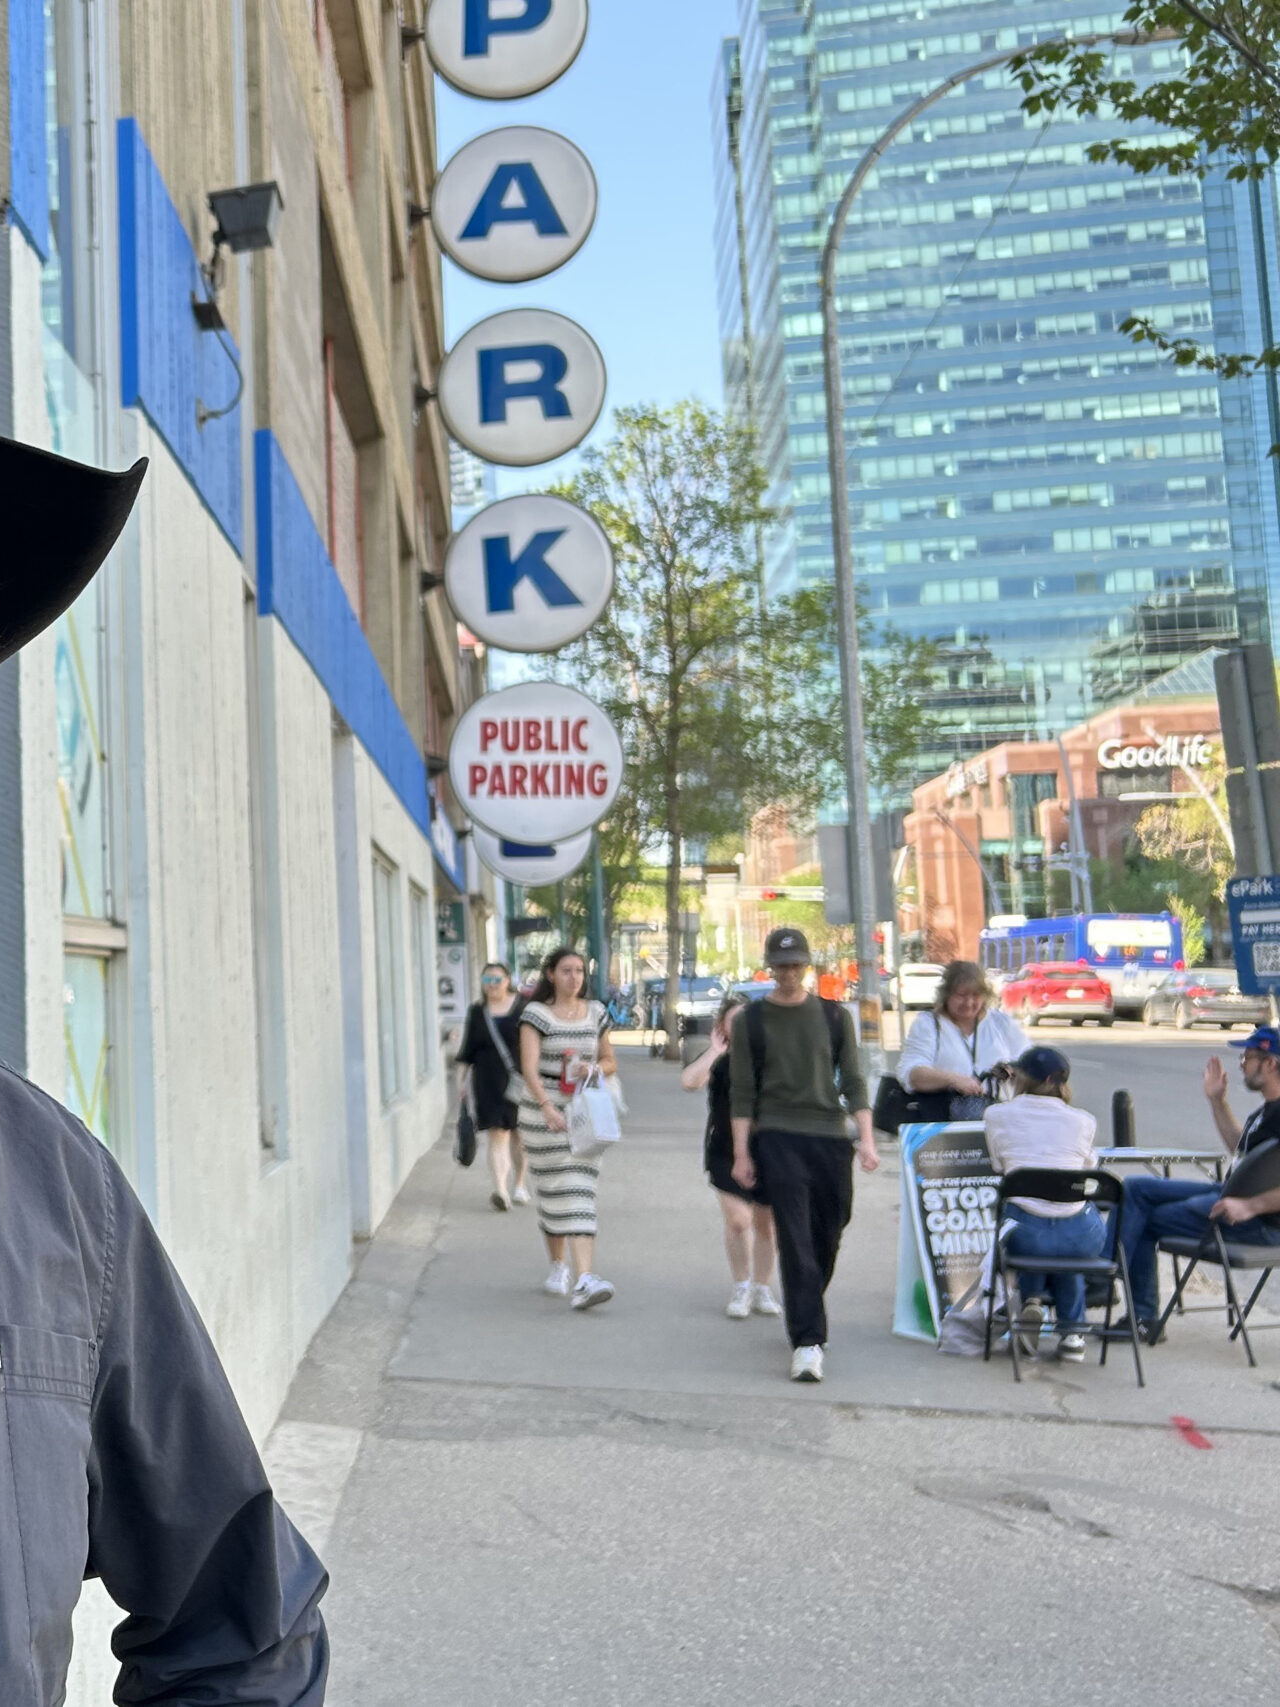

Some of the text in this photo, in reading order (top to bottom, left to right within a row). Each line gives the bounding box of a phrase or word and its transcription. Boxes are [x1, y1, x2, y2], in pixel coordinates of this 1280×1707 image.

[457, 0, 585, 616] PARK
[480, 719, 588, 752] PUBLIC
[1098, 734, 1213, 769] GoodLife
[469, 763, 608, 797] PARKING
[923, 1186, 998, 1212] STOP
[926, 1208, 997, 1233] COAL
